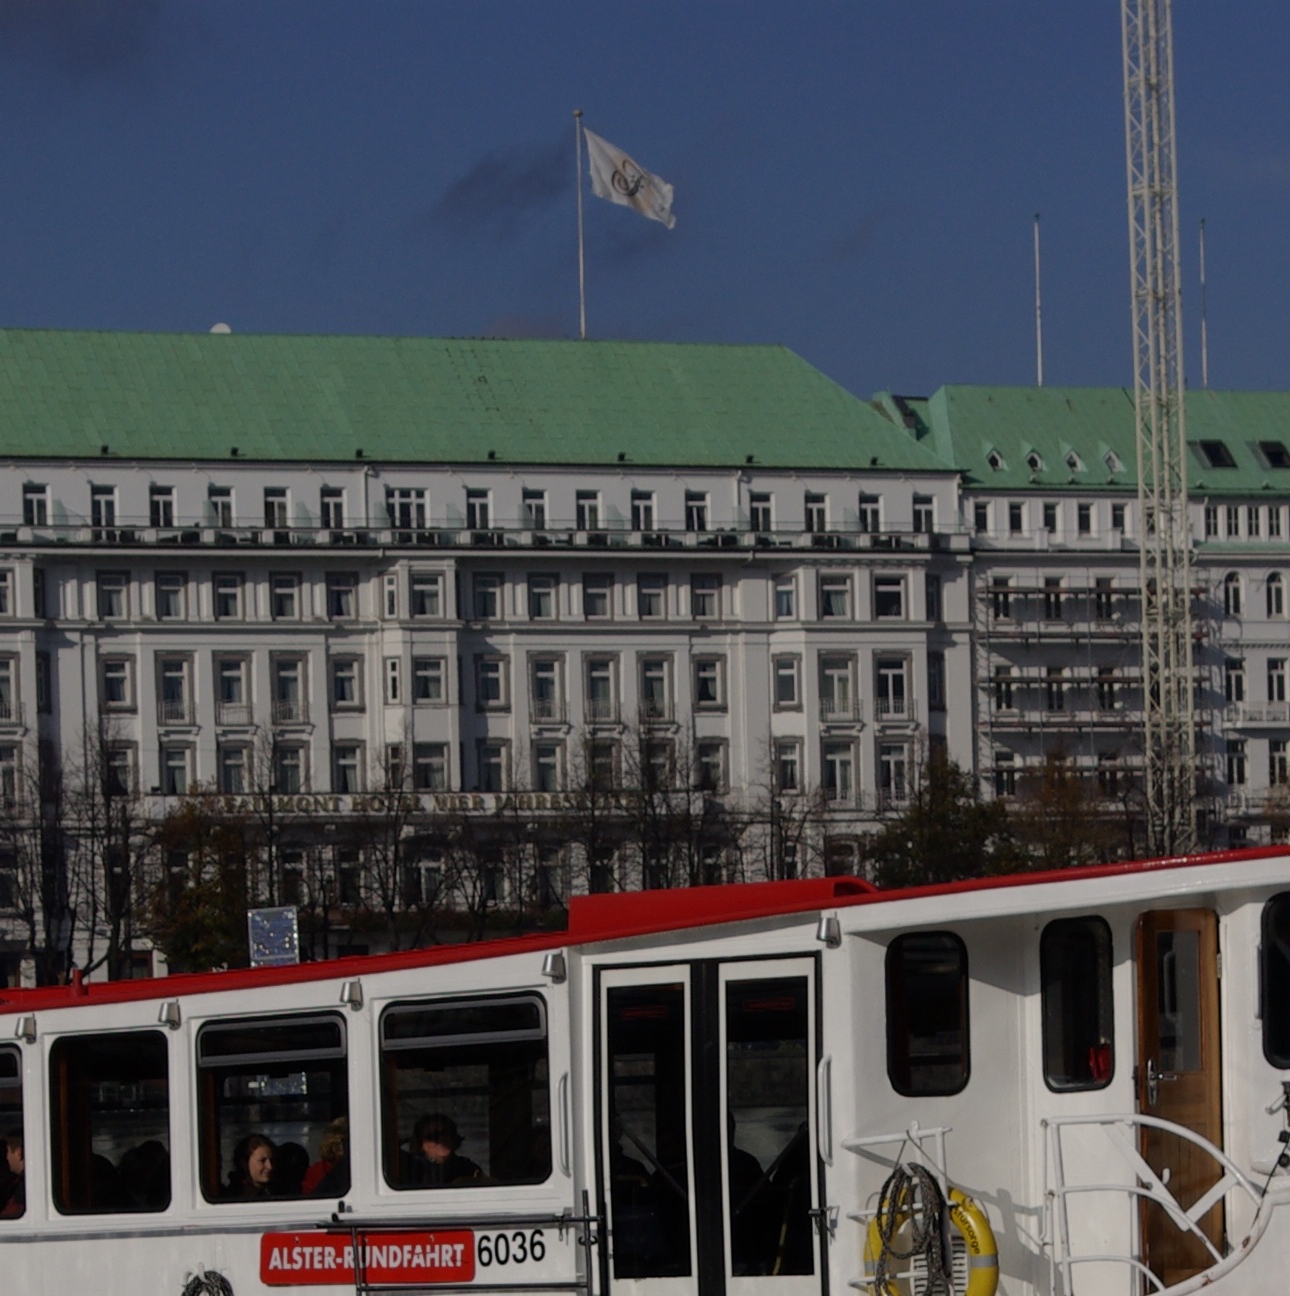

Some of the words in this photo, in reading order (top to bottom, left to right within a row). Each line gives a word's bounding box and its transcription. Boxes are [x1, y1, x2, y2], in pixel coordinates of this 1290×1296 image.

[433, 795, 486, 811] VIER
[268, 1243, 465, 1270] ALSTER-RUNDFAHRT
[478, 1229, 546, 1267] 6036
